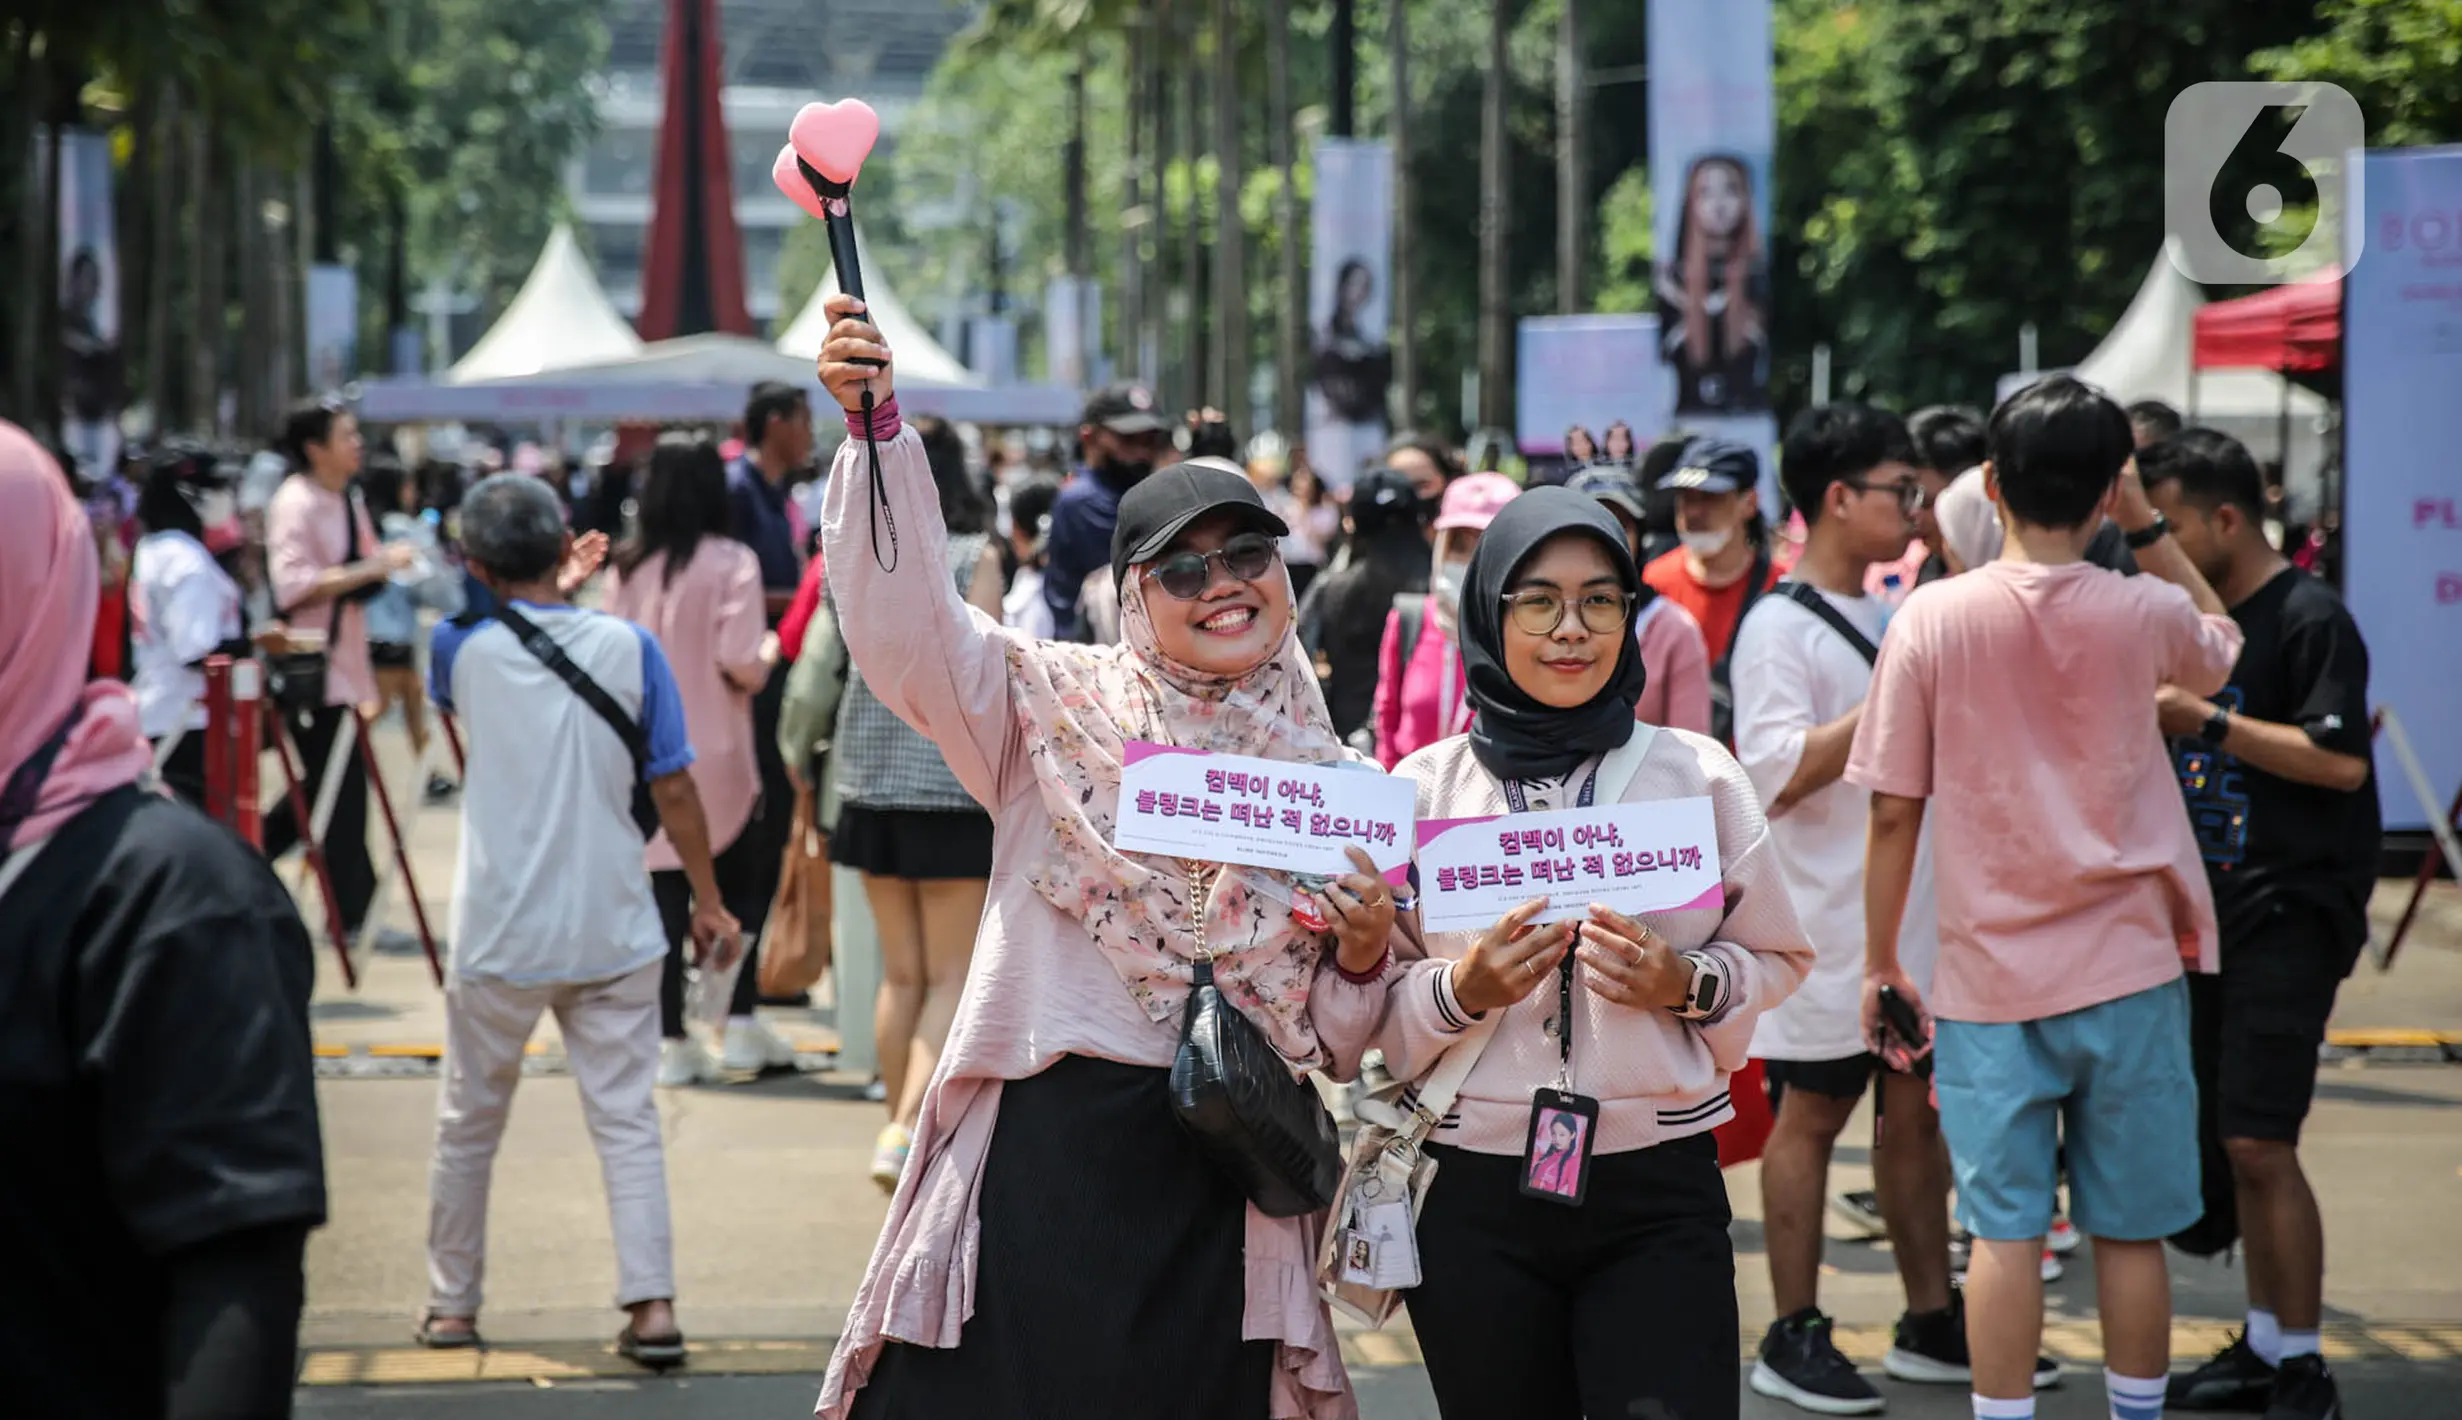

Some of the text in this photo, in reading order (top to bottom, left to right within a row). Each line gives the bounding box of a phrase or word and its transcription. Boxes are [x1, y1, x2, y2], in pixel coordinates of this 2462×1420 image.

[1205, 769, 1325, 808] 컴백이 아냐,
[1136, 789, 1222, 822] 블링크는
[1231, 803, 1274, 829] 떠난
[1281, 808, 1302, 833] 적
[1310, 813, 1396, 847] 없으니까
[1499, 822, 1624, 856] 컴백이 아냐,
[1437, 846, 1702, 892] 블링크는 떠난 적 없으니까
